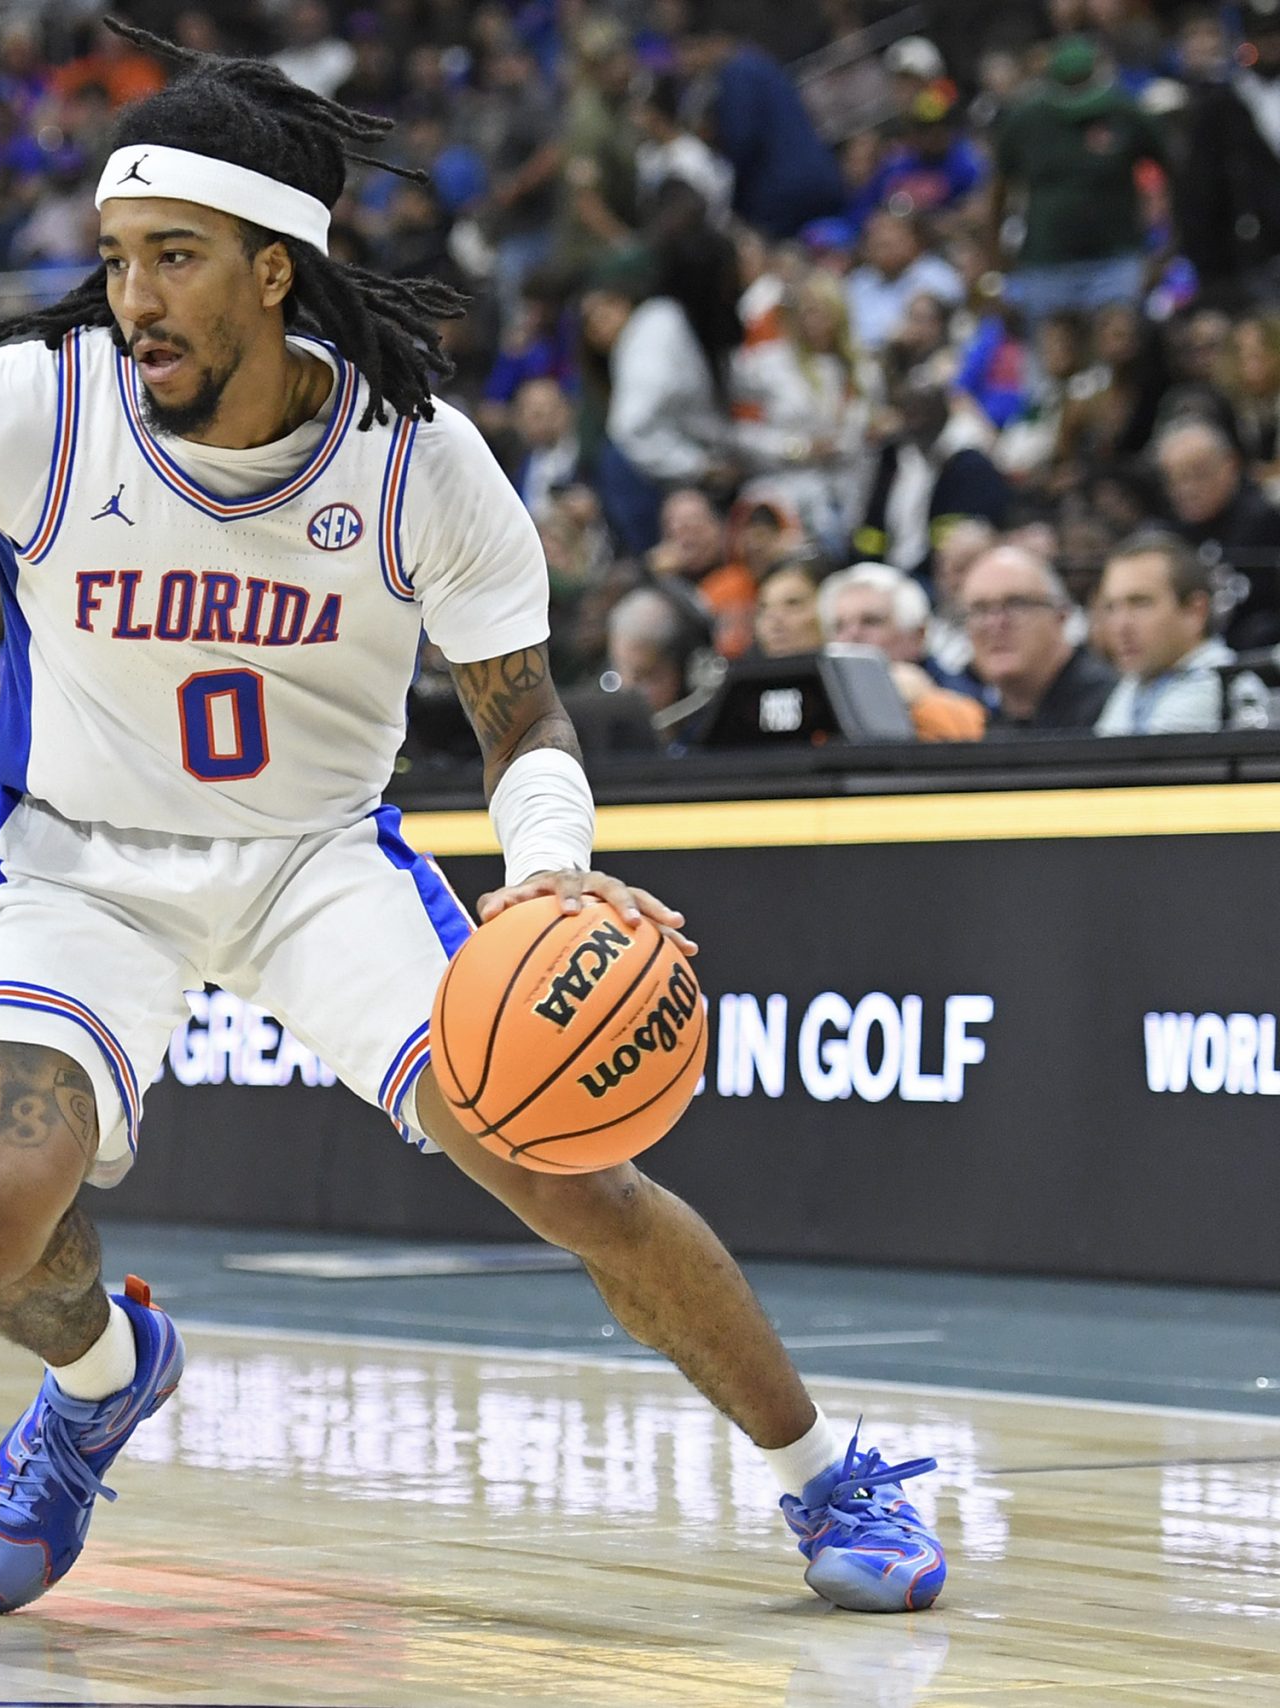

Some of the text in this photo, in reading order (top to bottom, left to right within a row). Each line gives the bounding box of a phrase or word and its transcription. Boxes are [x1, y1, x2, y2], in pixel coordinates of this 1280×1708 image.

[311, 506, 360, 550] SEC
[75, 569, 343, 646] FLORIDA
[176, 667, 271, 783] 0
[533, 919, 633, 1028] NCAA
[169, 987, 338, 1087] GREA
[717, 992, 788, 1098] IN
[797, 991, 995, 1102] GOLF
[576, 961, 698, 1099] Wilson
[1143, 1011, 1280, 1095] WORL
